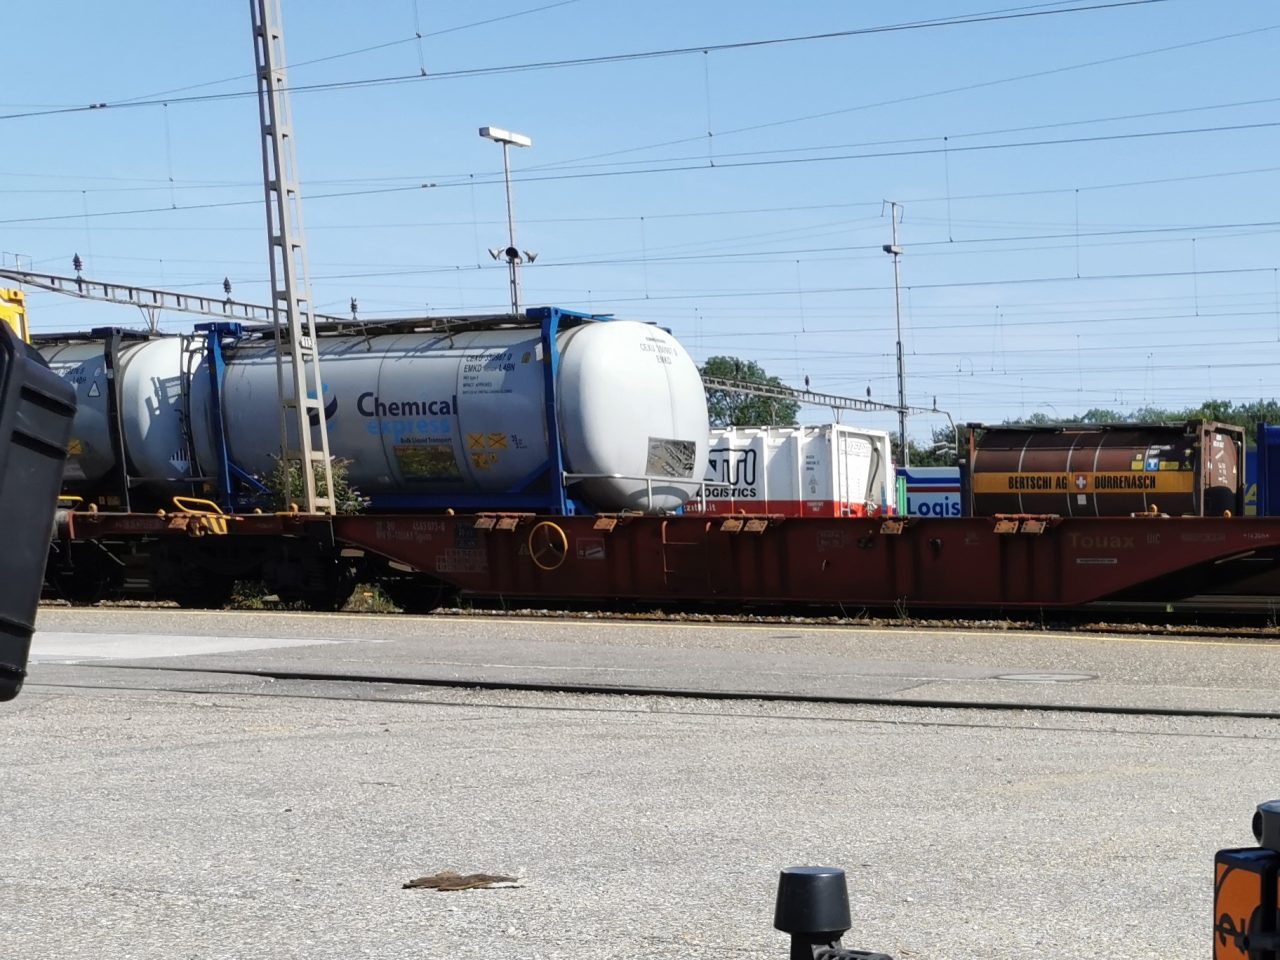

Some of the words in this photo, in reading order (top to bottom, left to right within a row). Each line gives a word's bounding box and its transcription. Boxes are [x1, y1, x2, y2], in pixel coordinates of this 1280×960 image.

[357, 392, 457, 417] Chemical
[367, 420, 450, 444] express
[1008, 476, 1052, 490] BERTSCHI
[1055, 476, 1067, 490] AG
[1070, 532, 1136, 549] Touax
